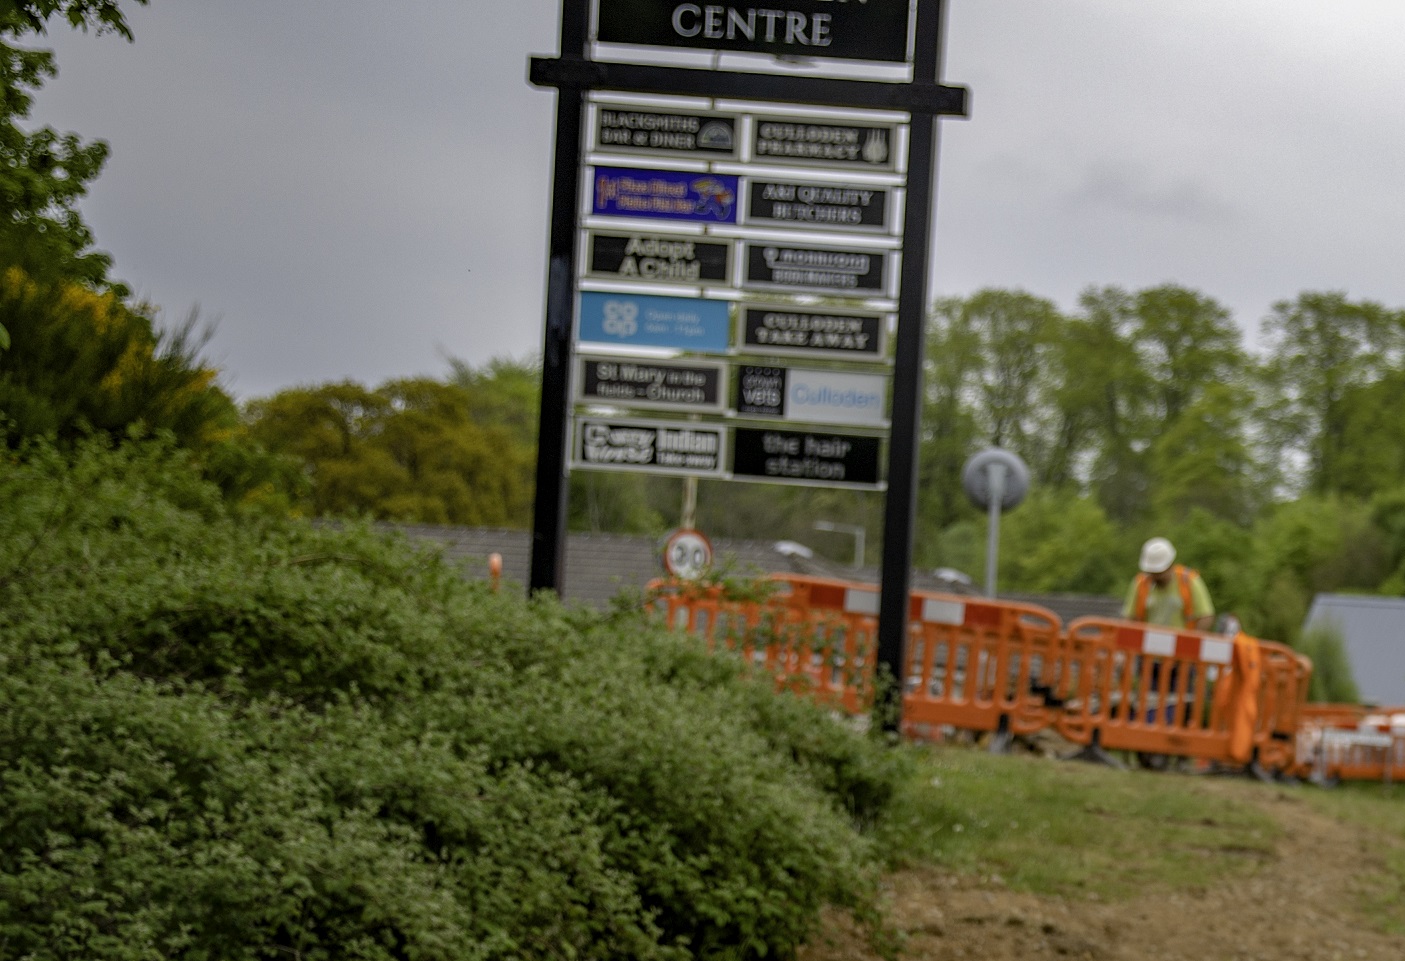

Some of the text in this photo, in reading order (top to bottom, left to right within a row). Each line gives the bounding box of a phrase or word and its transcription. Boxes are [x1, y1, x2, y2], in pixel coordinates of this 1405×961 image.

[672, 3, 833, 46] CENTRE
[625, 237, 697, 263] Adopt
[619, 257, 701, 281] A Child
[790, 383, 880, 409] Culloden
[762, 432, 850, 458] the hair
[765, 455, 846, 480] station
